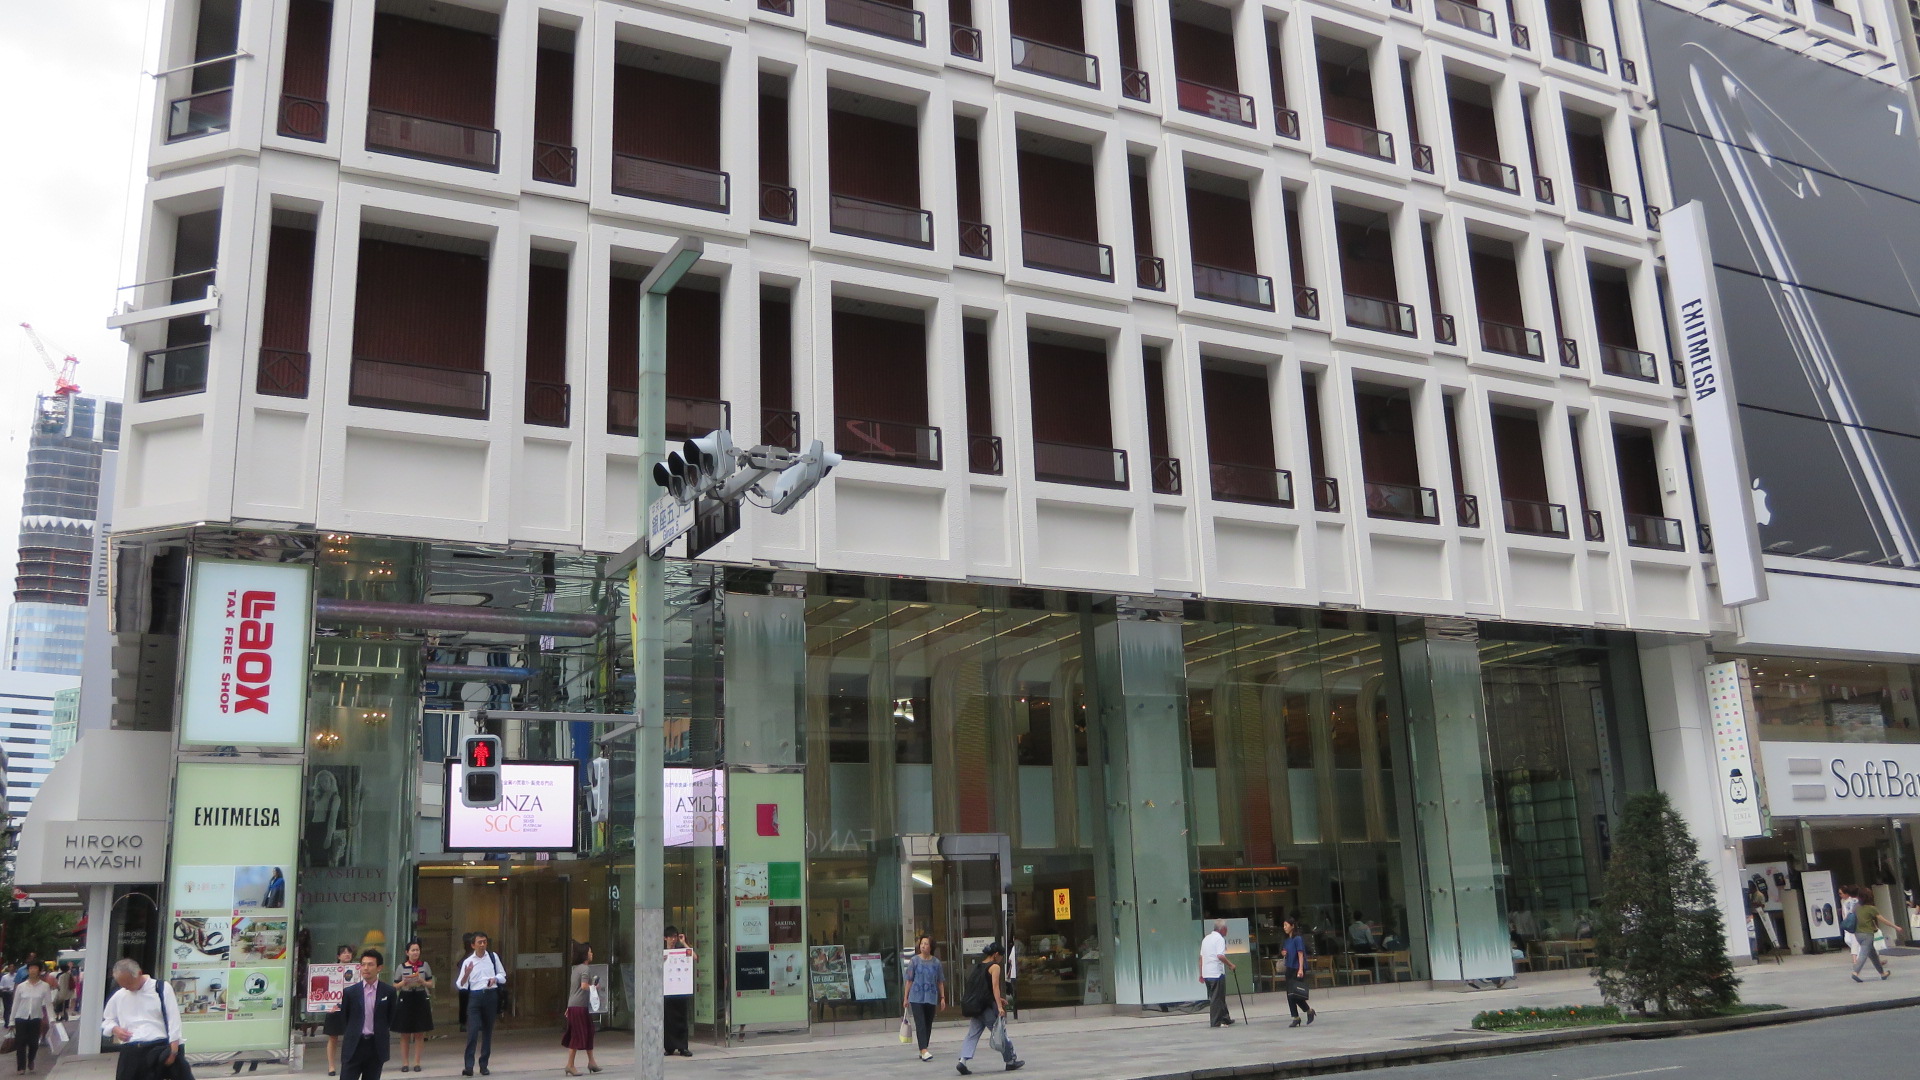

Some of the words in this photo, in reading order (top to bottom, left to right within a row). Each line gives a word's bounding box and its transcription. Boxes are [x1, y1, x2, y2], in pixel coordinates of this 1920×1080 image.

[1681, 298, 1716, 402] EXITMELSA
[663, 526, 675, 541] Ginza
[675, 520, 680, 532] 5
[226, 588, 237, 618] TAX
[222, 627, 234, 665] FREE
[219, 672, 231, 714] SHOP
[194, 806, 281, 827] EXITMELSA
[484, 814, 521, 833] SGC
[65, 835, 143, 849] HIROKO
[64, 855, 142, 869] HAYASHI
[326, 868, 384, 879] ASHLEY
